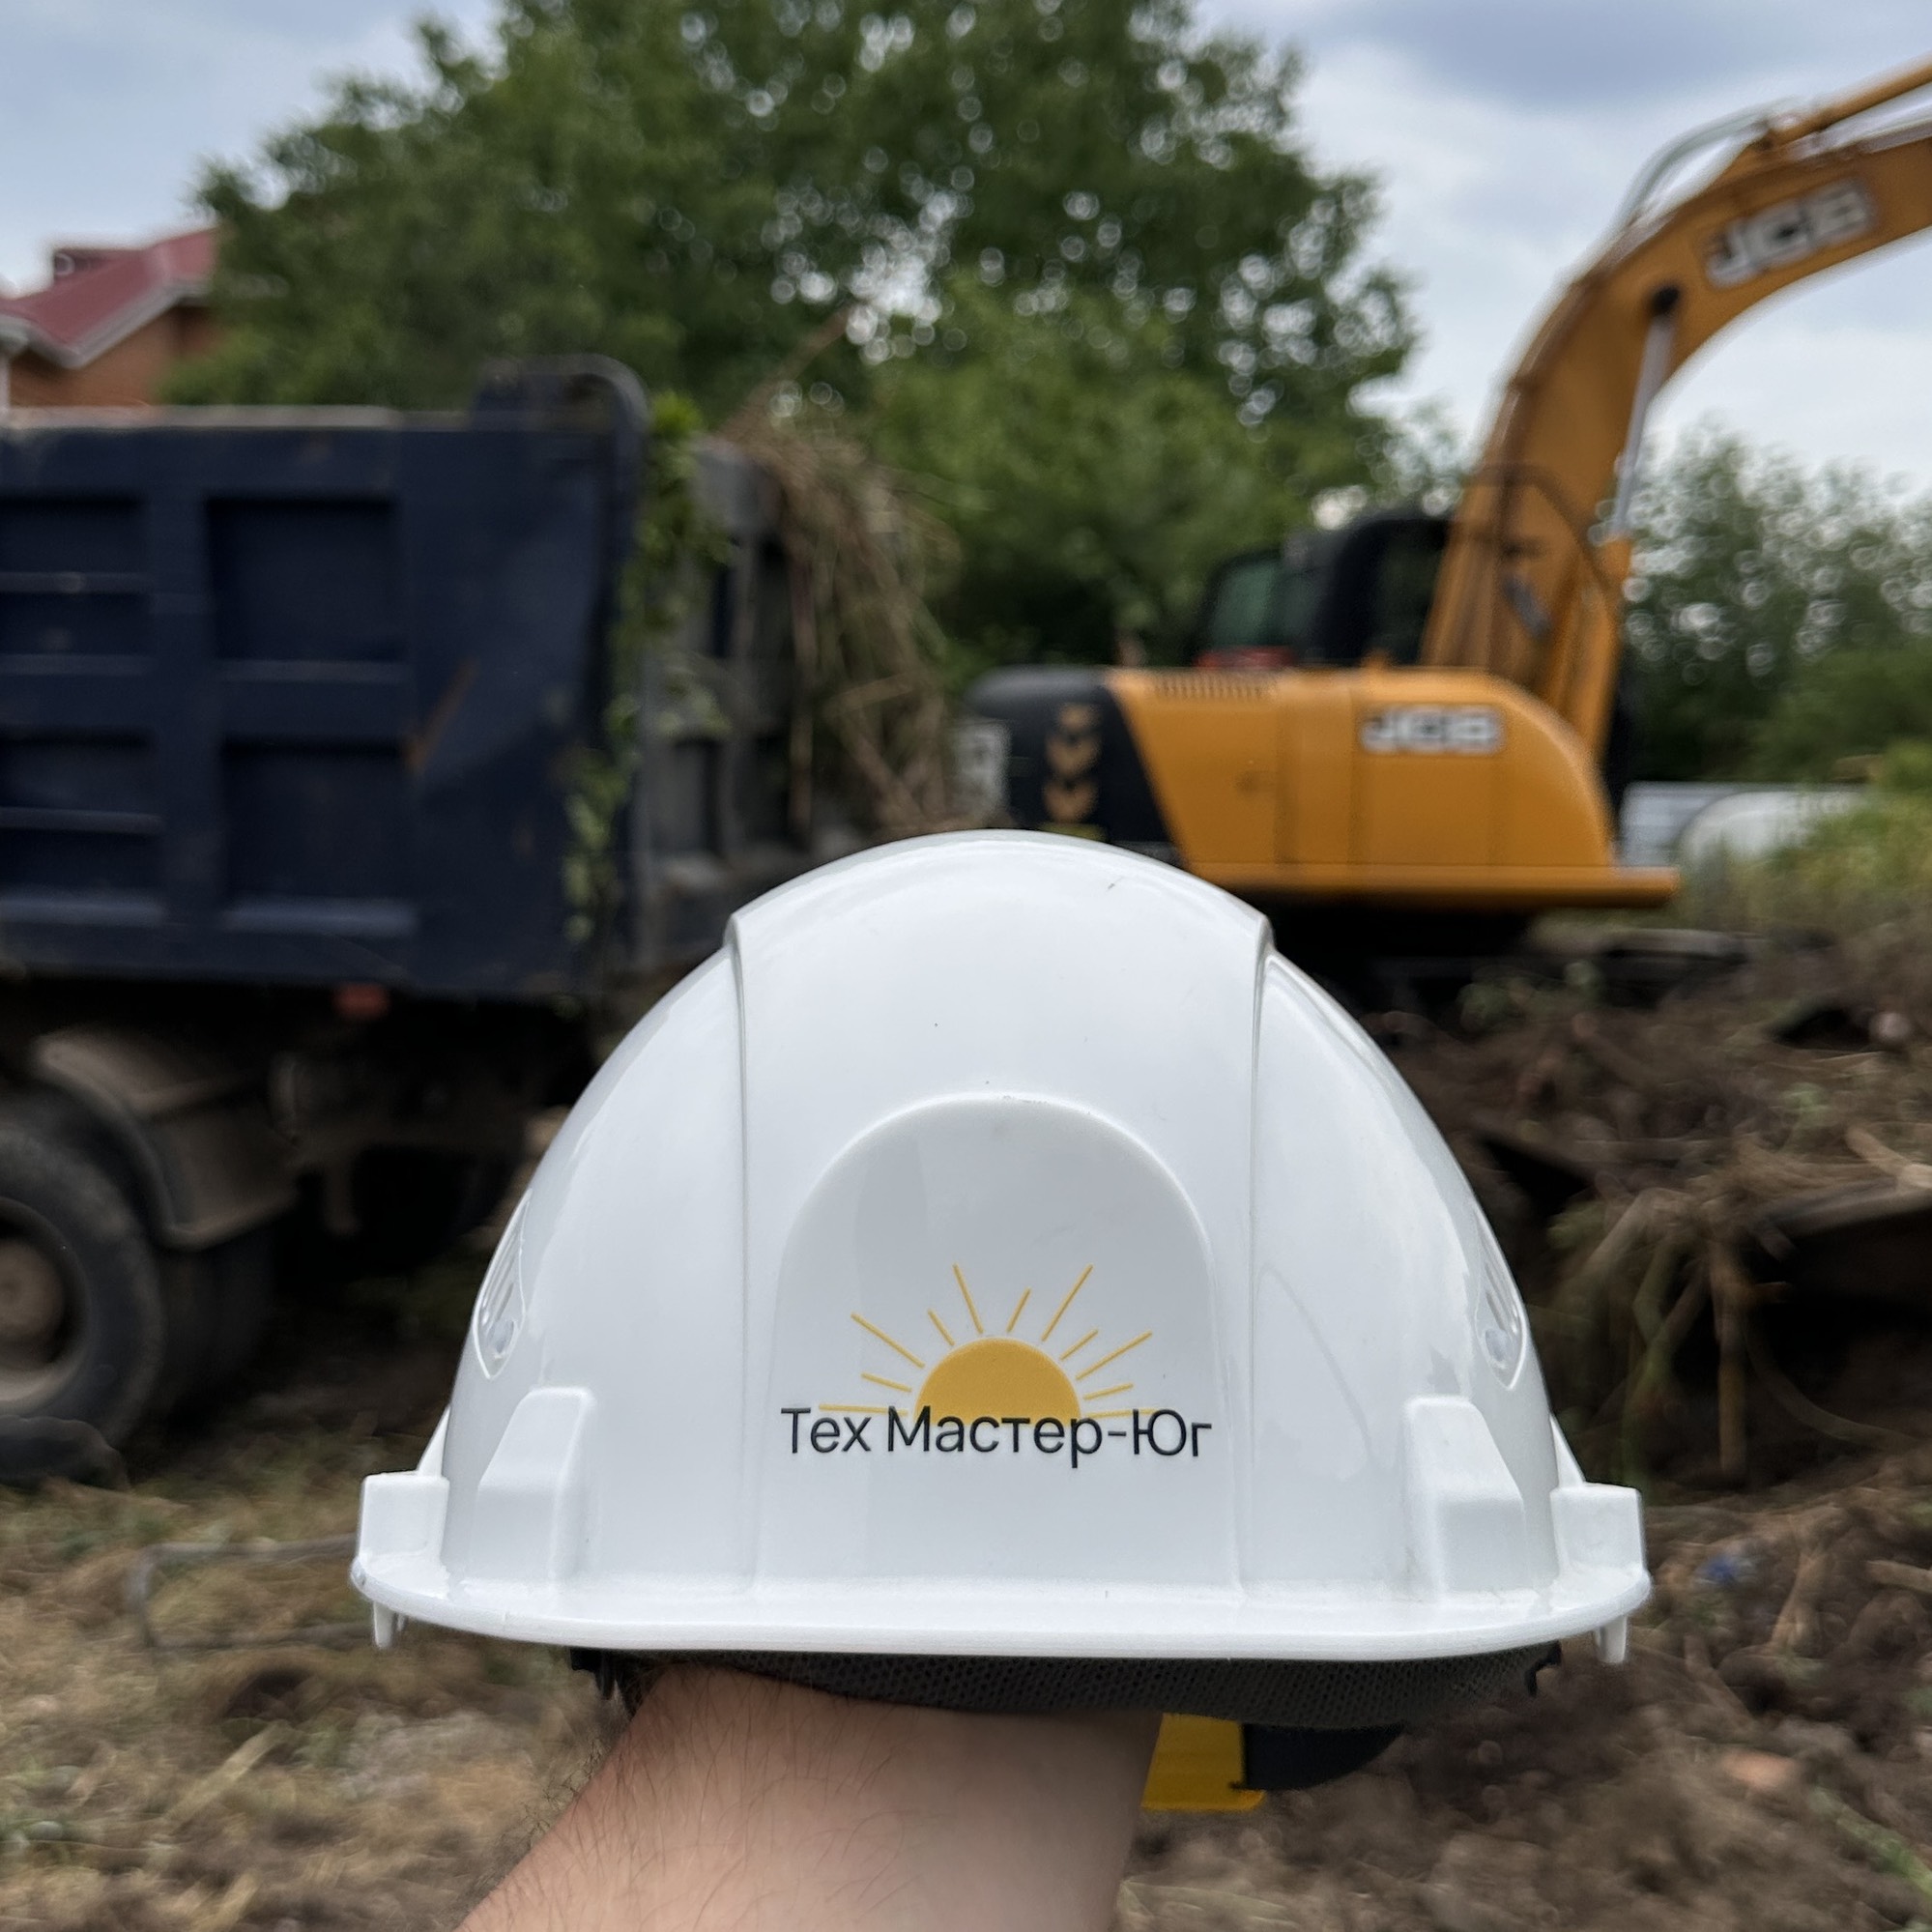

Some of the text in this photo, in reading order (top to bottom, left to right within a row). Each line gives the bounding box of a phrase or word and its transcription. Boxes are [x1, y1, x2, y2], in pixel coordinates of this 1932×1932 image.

[1709, 182, 1869, 282] JCB
[1361, 707, 1502, 753] JCB
[781, 1405, 1213, 1469] Тех Мастер-Юг
